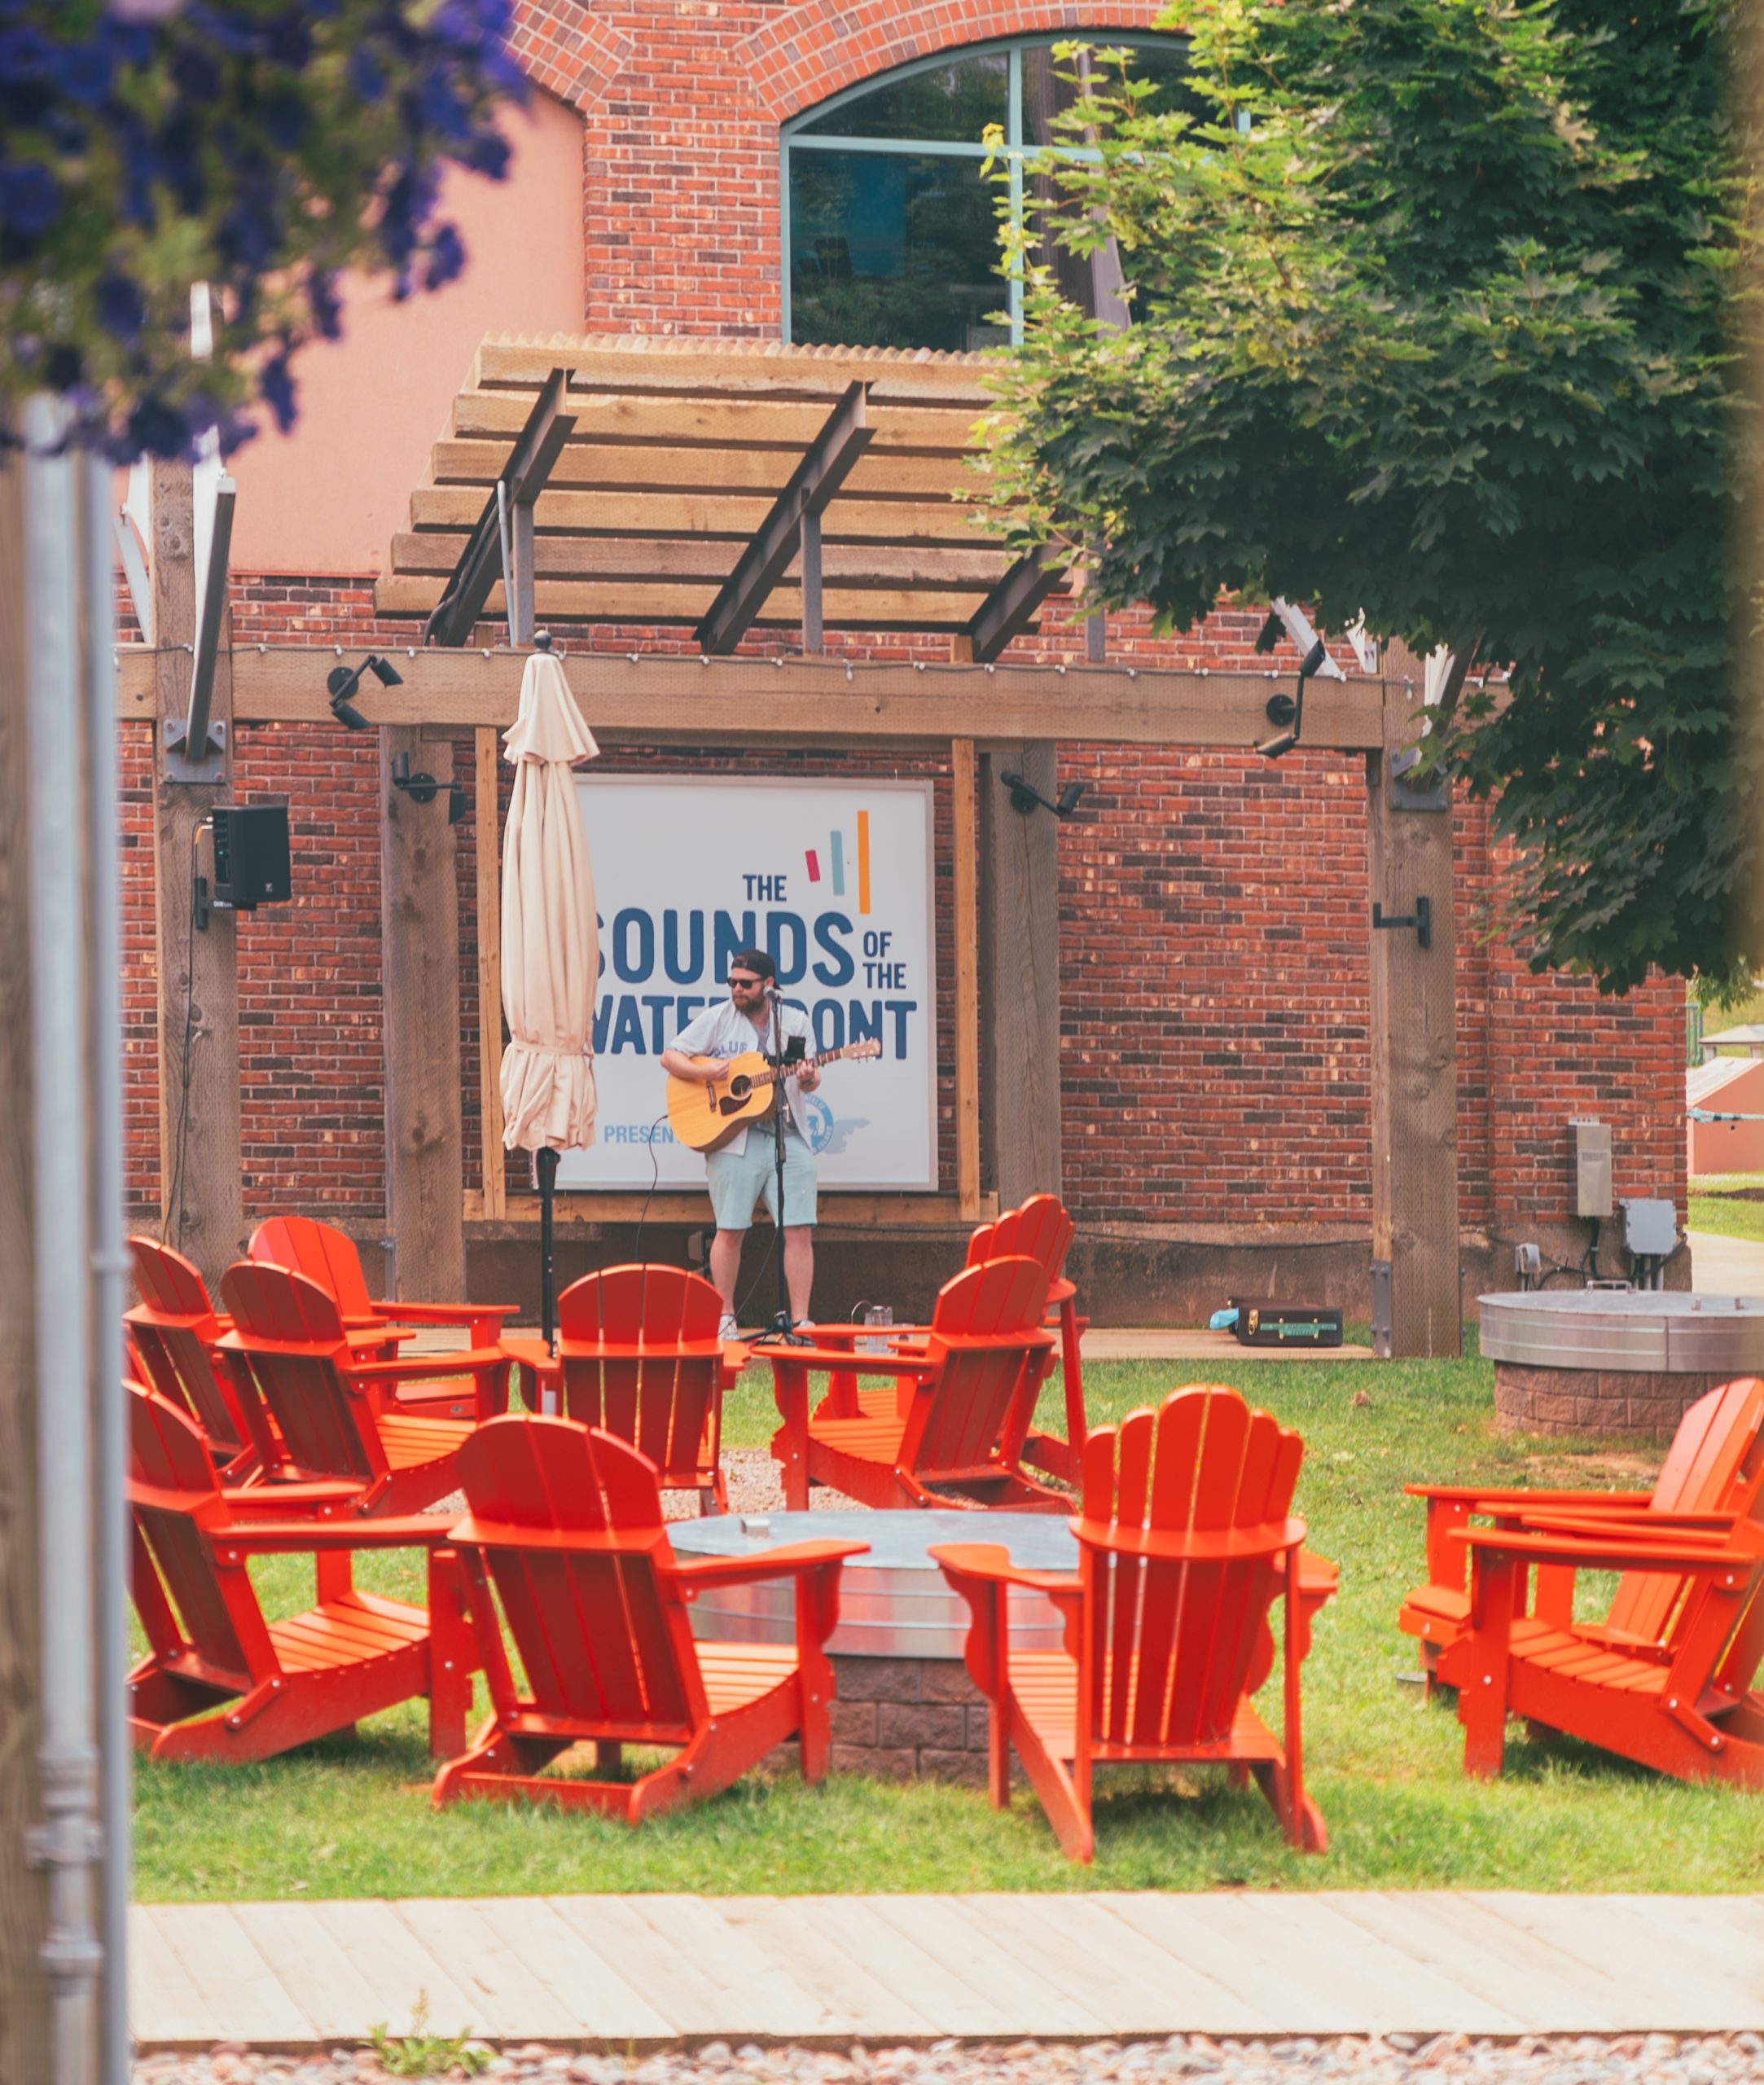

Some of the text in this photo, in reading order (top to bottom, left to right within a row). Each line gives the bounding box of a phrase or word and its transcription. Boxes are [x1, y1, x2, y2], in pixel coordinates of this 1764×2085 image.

[743, 875, 788, 902] THE
[596, 908, 855, 988] OUNDS
[863, 932, 893, 957] OF
[863, 963, 906, 990] THE
[604, 1125, 681, 1143] PRESEN
